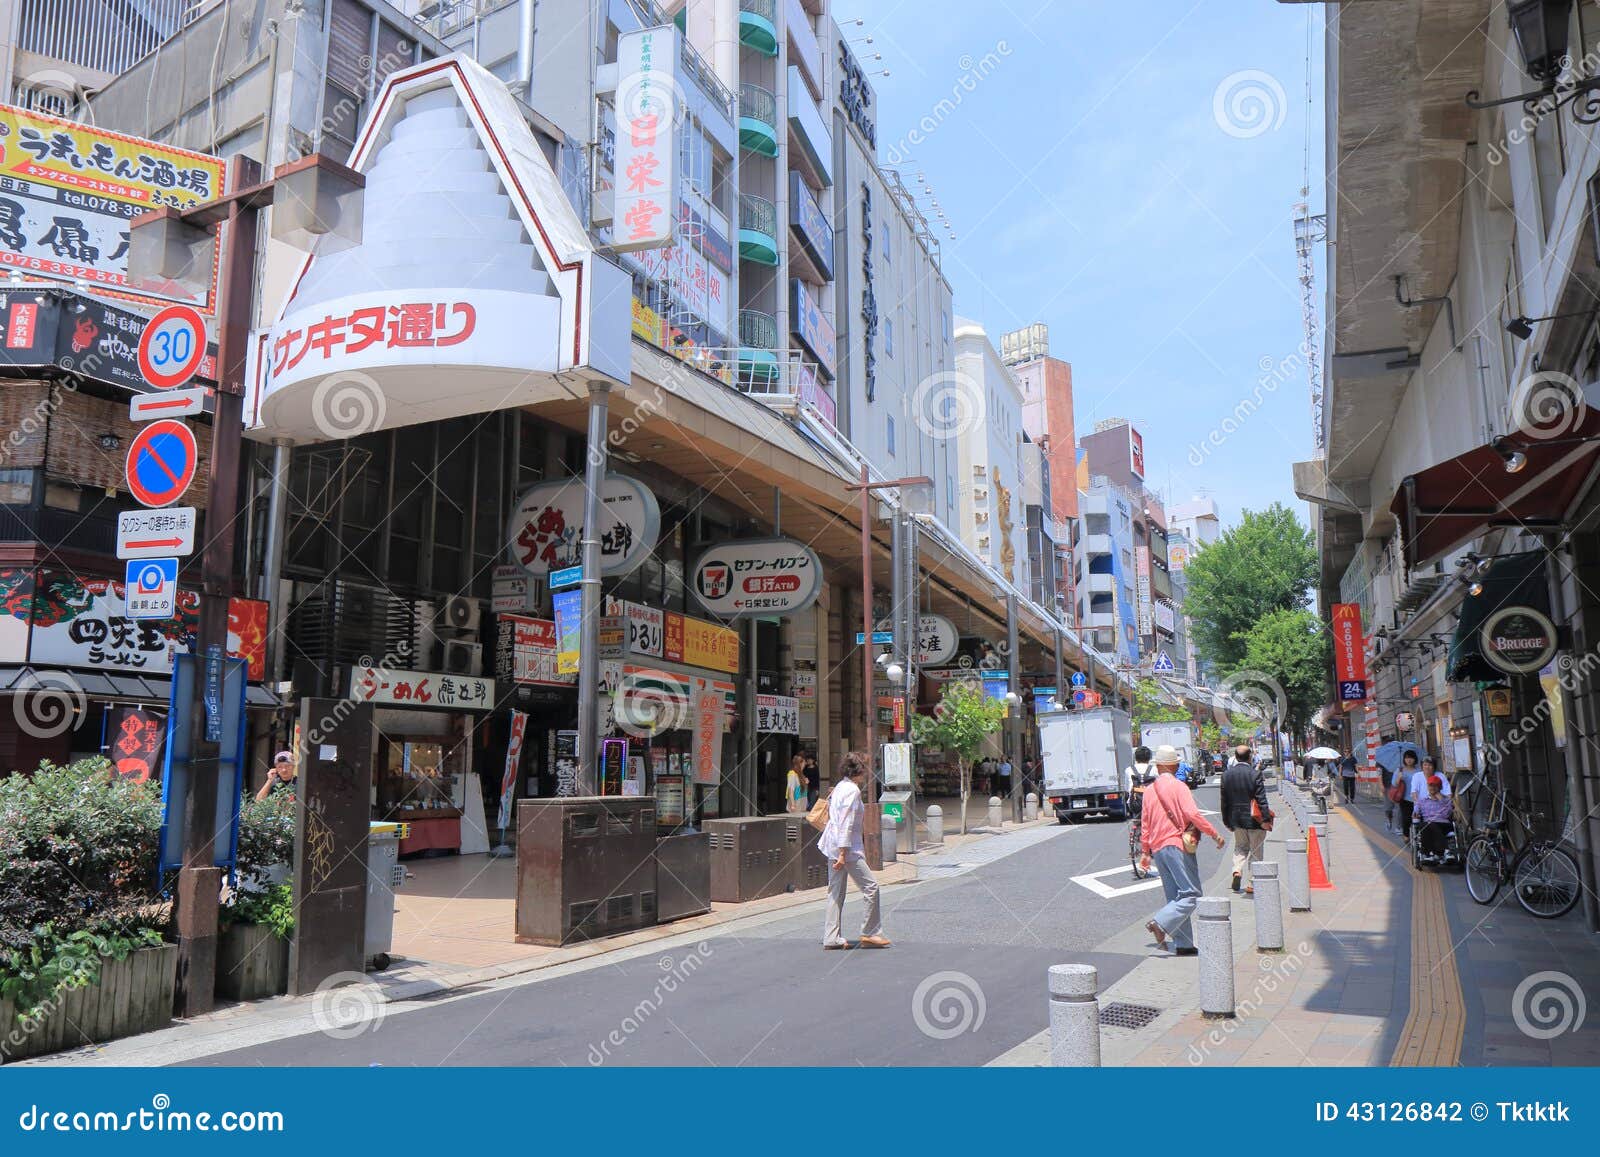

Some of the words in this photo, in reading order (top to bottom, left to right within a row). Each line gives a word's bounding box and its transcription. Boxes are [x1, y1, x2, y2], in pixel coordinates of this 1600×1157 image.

[19, 127, 209, 198] うまいもん酒場
[624, 114, 664, 241] 日栄堂
[64, 191, 151, 218] tel.078-39
[13, 304, 33, 348] 大阪名物
[273, 302, 476, 378] サンキタ通り
[153, 328, 190, 365] 30
[745, 598, 789, 608] 日栄堂ビル
[69, 614, 165, 652] 四天王
[1496, 636, 1542, 650] BRUGGE
[89, 646, 147, 667] ラーメン
[361, 668, 432, 704] らーめん
[438, 677, 487, 707] 熊五郎
[758, 707, 797, 732] 豊丸水産
